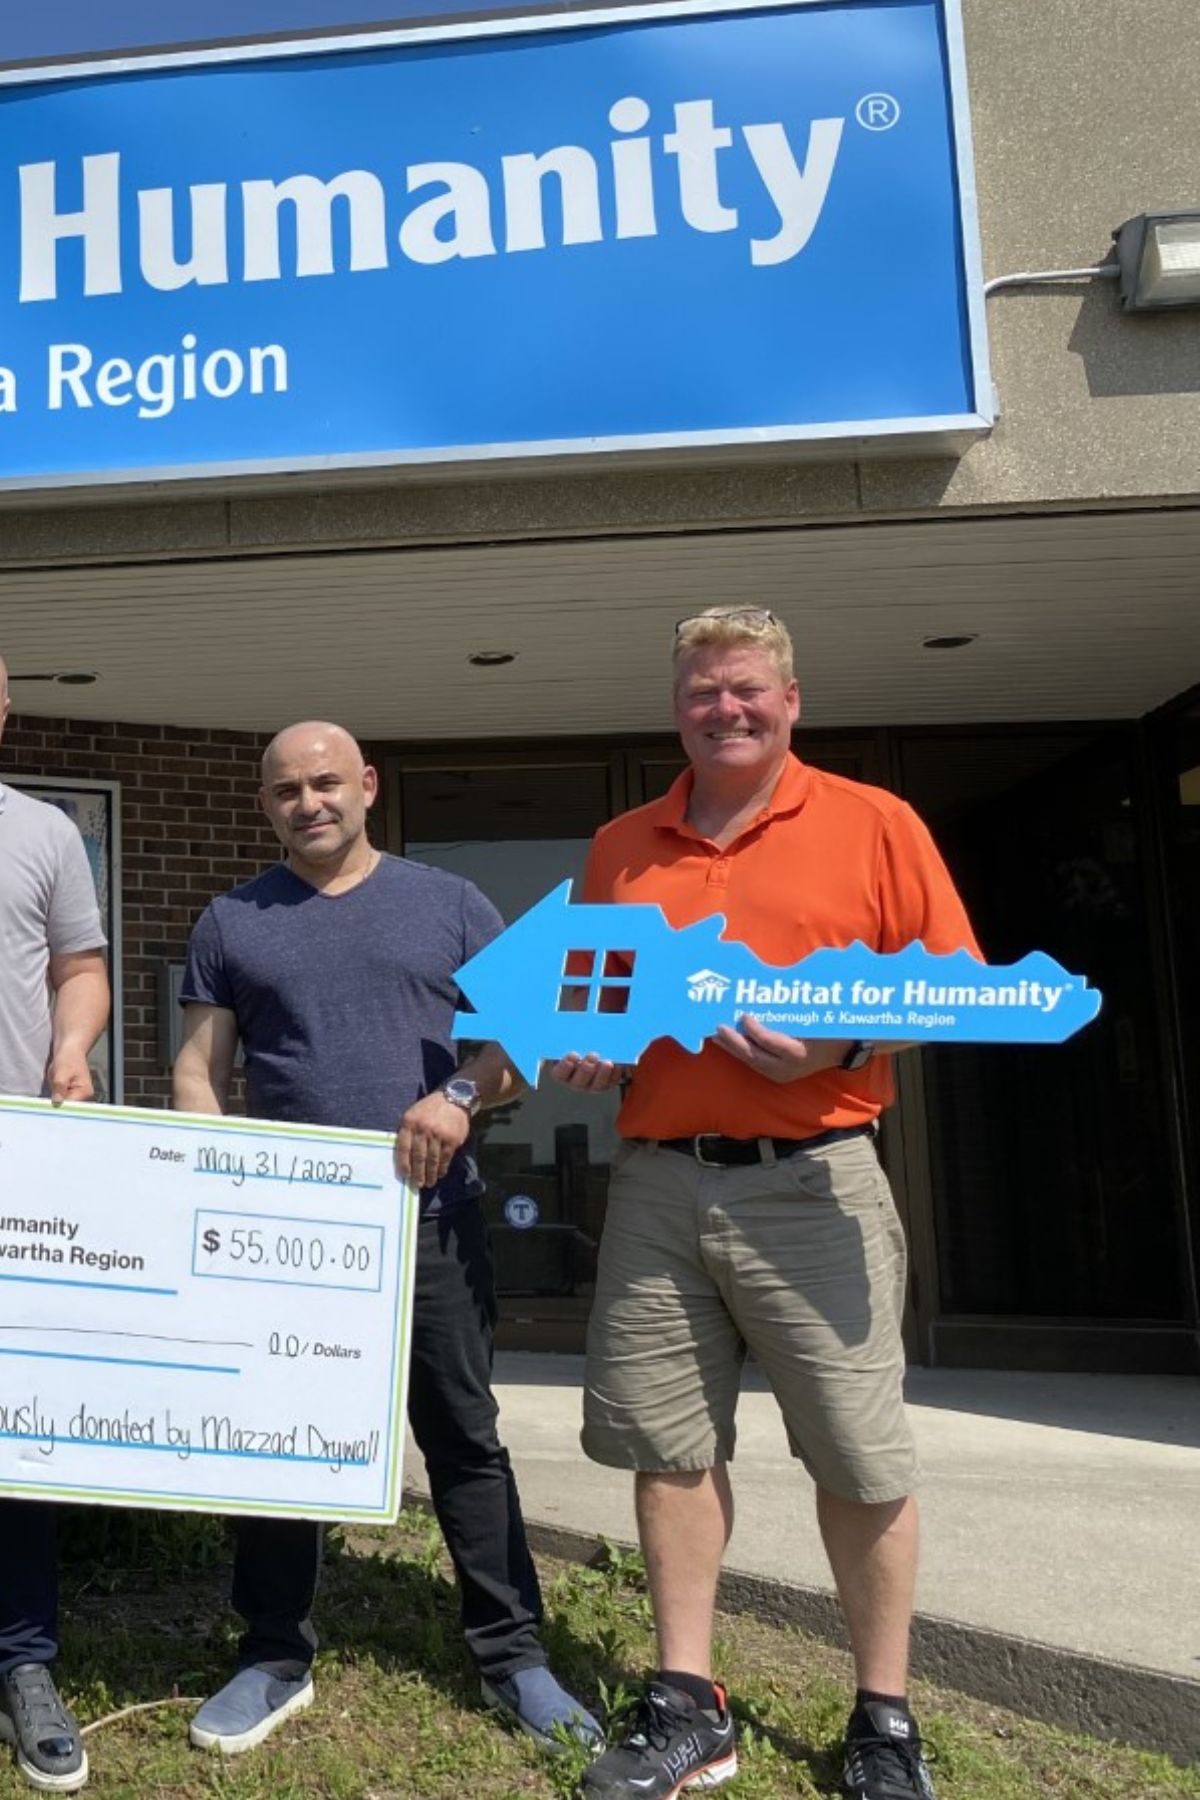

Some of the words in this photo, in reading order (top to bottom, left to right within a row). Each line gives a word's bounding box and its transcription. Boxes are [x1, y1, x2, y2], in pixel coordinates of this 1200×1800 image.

[18, 96, 845, 303] Humanity
[47, 334, 288, 418] Region
[735, 977, 842, 1005] Habitat
[851, 981, 895, 1005] for
[903, 980, 1063, 1013] Humanity
[733, 1009, 820, 1026] Pterborough
[823, 1011, 834, 1024] &
[839, 1010, 903, 1025] Kawartha
[907, 1012, 956, 1029] Region
[148, 1146, 186, 1164] Date:
[198, 1145, 246, 1187] May
[69, 1244, 144, 1273] Region
[313, 1341, 361, 1360] Dollars
[68, 1402, 155, 1446] donated
[166, 1409, 191, 1460] by
[201, 1415, 297, 1456] Mazzad
[307, 1423, 380, 1473] Drywall
